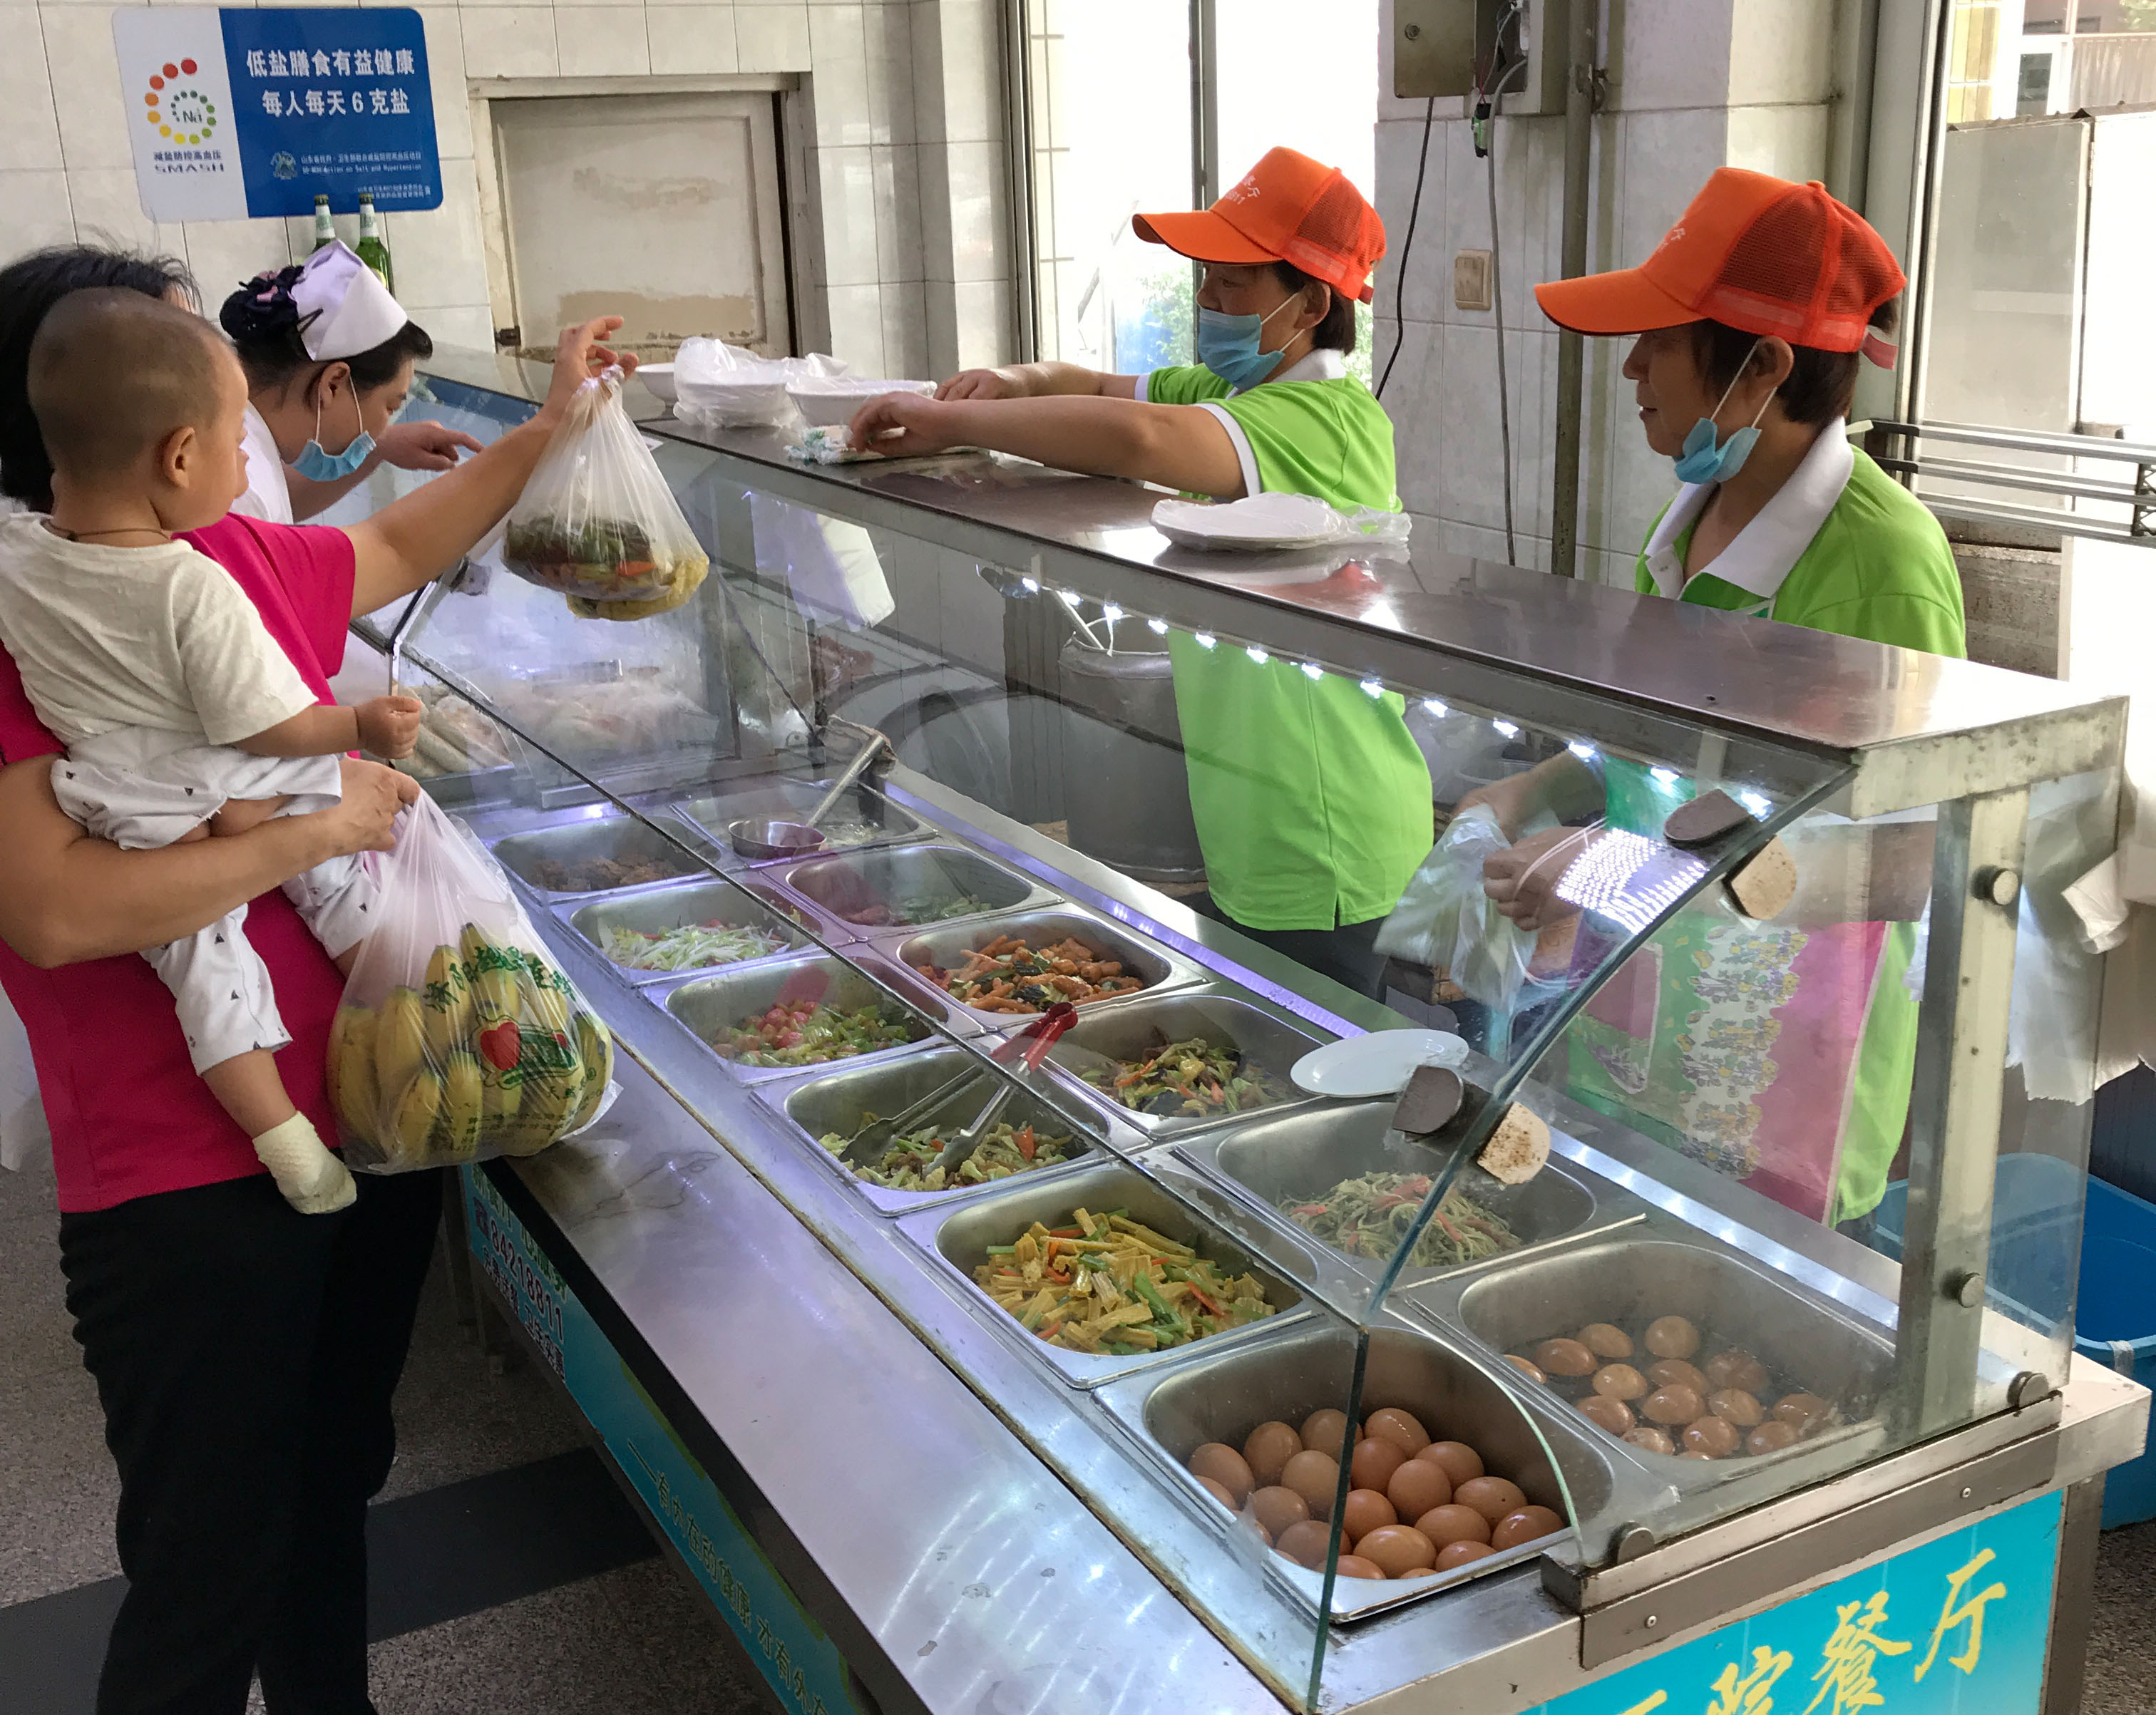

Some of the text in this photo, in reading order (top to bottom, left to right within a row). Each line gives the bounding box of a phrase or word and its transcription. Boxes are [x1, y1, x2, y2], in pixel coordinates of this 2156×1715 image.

[247, 48, 415, 78] 低盐膳食有益健康
[490, 1215, 564, 1344] 84218811
